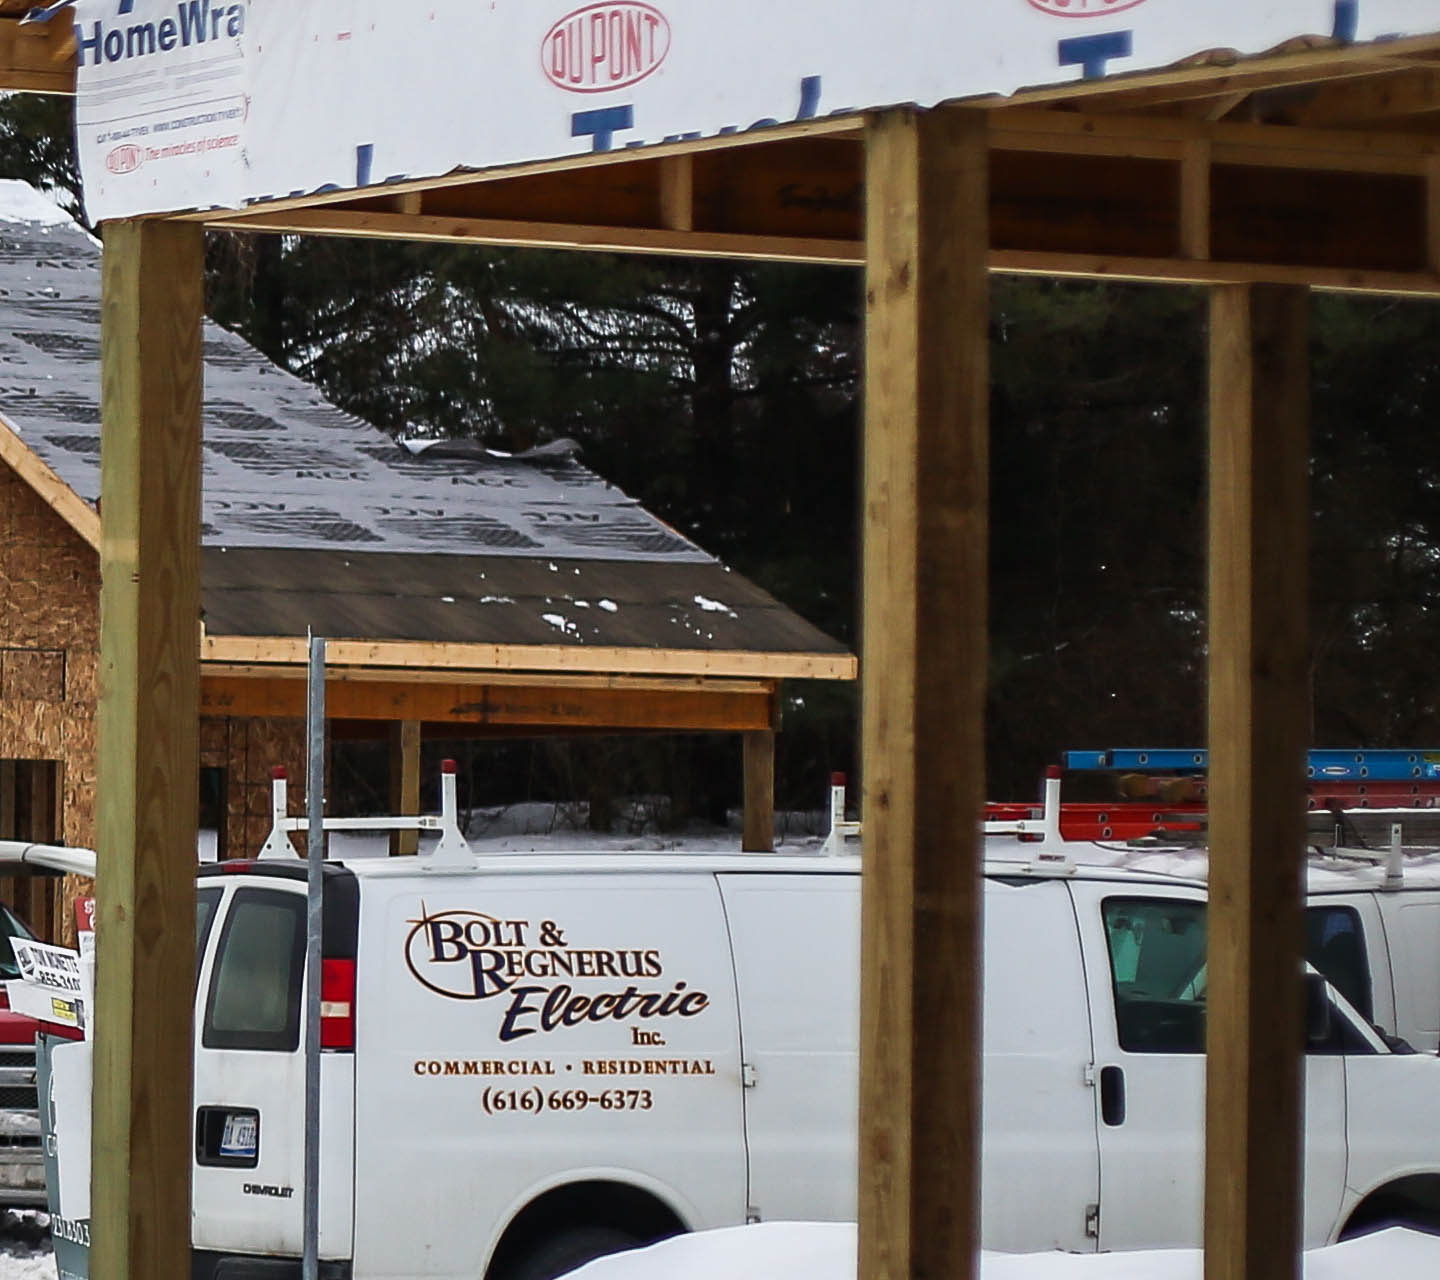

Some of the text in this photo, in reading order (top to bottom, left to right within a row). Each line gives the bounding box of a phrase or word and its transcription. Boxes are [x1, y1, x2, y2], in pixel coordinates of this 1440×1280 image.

[429, 918, 568, 963] BOLT &
[467, 947, 663, 999] REGNERUS
[498, 980, 710, 1042] Electric
[631, 1026, 666, 1046] Inc.
[413, 1059, 716, 1076] COMMERCIAL RESIDENTIAL
[481, 1085, 653, 1115] (616) 669-6373
